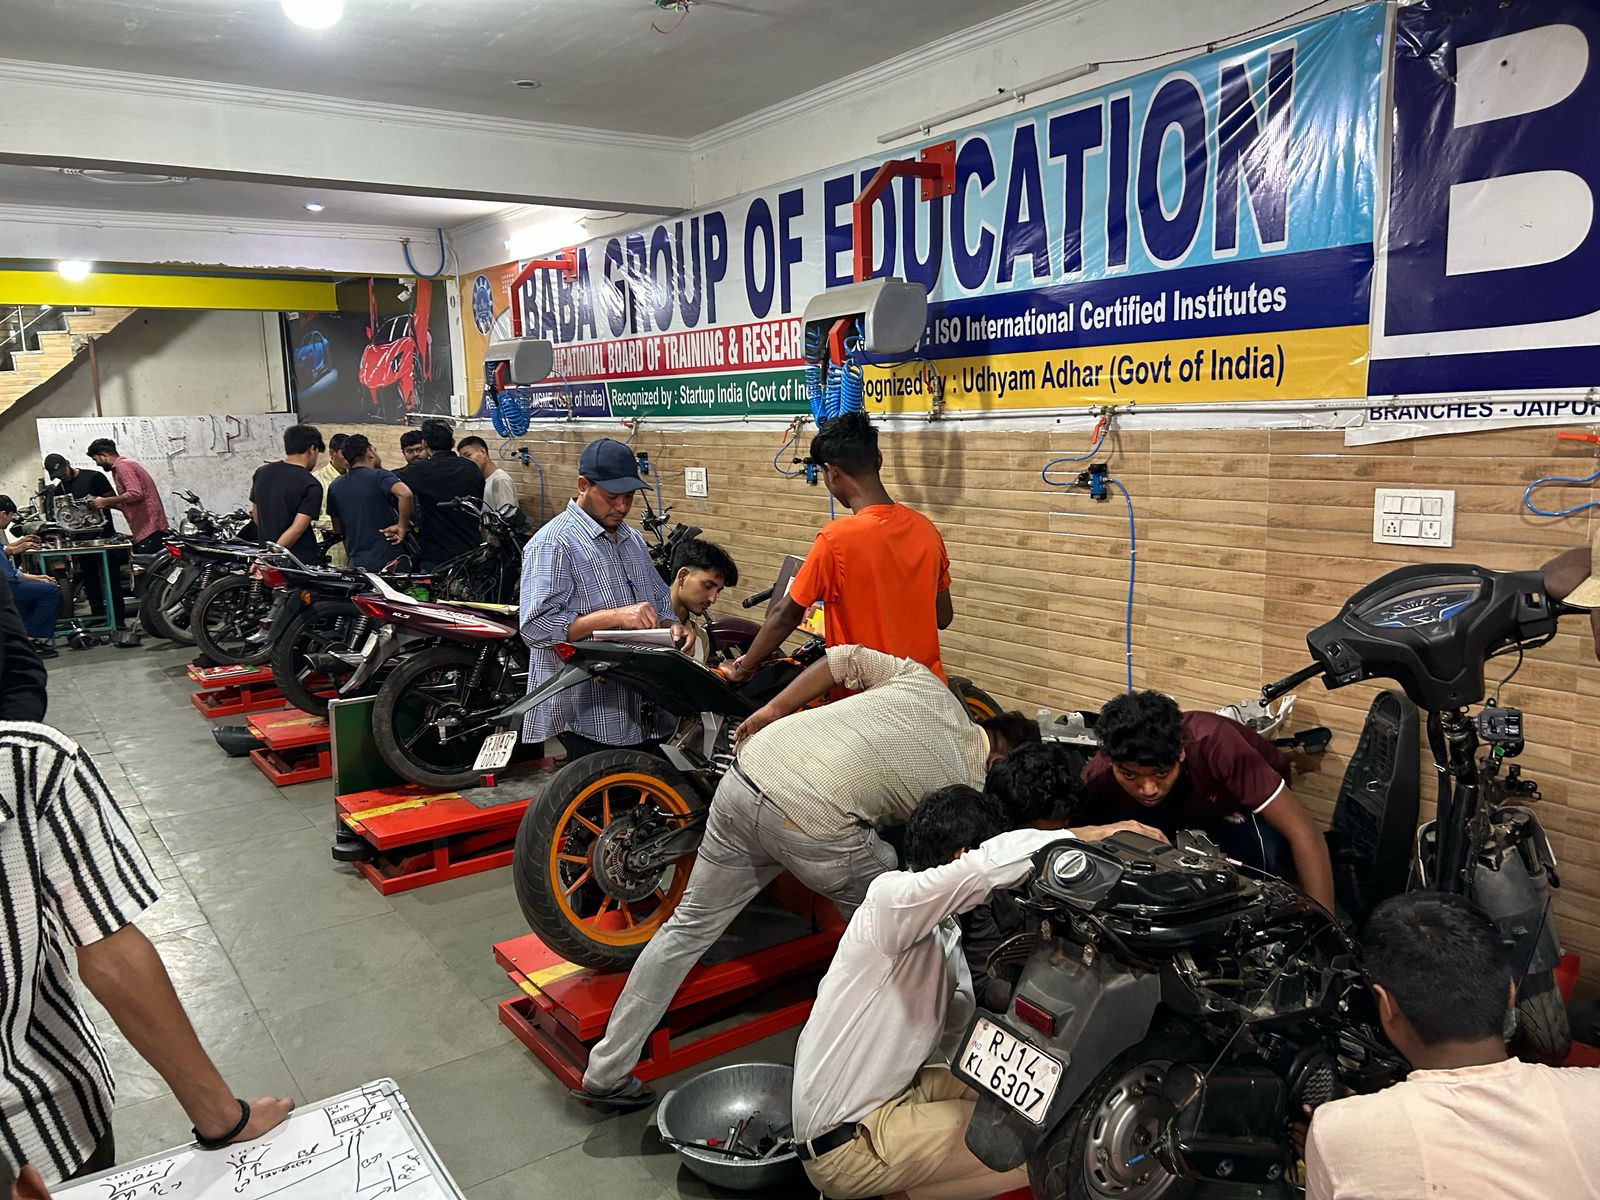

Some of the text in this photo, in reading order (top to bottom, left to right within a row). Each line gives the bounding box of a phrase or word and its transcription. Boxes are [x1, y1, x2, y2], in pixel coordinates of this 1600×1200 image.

[522, 248, 597, 343] BABA
[603, 211, 728, 337] GROUP
[744, 189, 804, 319] OF
[823, 45, 1297, 296] EDUCATION
[935, 316, 961, 345] ISO
[966, 303, 1074, 342] International
[1080, 292, 1166, 331] Certified
[1173, 282, 1287, 321] Institutes
[607, 339, 644, 374] BOARD
[647, 337, 661, 371] OF
[663, 329, 724, 370] TRAINING
[728, 328, 739, 365] &
[742, 320, 801, 363] RESEAR
[863, 371, 923, 403] ognized
[962, 366, 1035, 398] Udhyam
[1041, 358, 1103, 390] Adhar
[1109, 353, 1172, 394] (Govt
[1179, 349, 1204, 387] of
[1211, 344, 1285, 387] India)
[574, 389, 583, 407] of
[584, 388, 605, 411] India)
[611, 386, 660, 410] Recognized
[661, 385, 672, 410] by
[679, 384, 715, 409] Startup
[718, 382, 743, 404] India
[746, 381, 776, 408] (Govt
[779, 379, 792, 401] of
[1369, 401, 1493, 421] BRANCHES
[965, 1051, 1045, 1112] KL 6307
[988, 1029, 1040, 1080] RJ14
